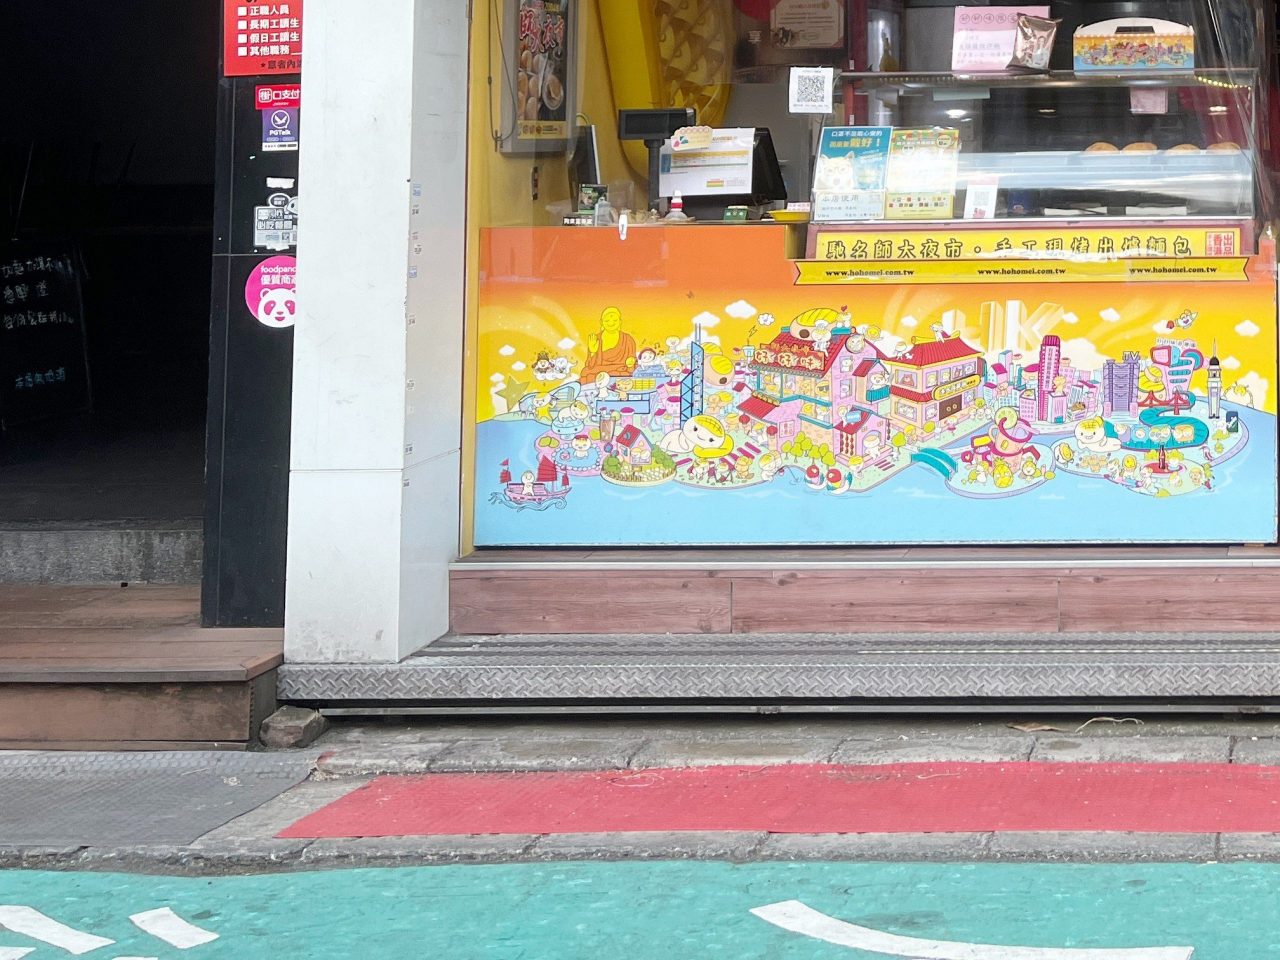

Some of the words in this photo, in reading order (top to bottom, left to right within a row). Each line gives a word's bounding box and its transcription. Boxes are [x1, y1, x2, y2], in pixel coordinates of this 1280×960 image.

[250, 5, 290, 16] 正職人員
[250, 19, 300, 30] 長期工讀生
[250, 33, 300, 43] 假日工讀生
[250, 47, 290, 56] 其他職務
[258, 88, 300, 103] 街口支付
[825, 269, 914, 277] www.hohomei.com.tw
[977, 267, 1066, 276] www.hohomei.com.tw
[1129, 266, 1217, 274] www.hohomei.com.tw
